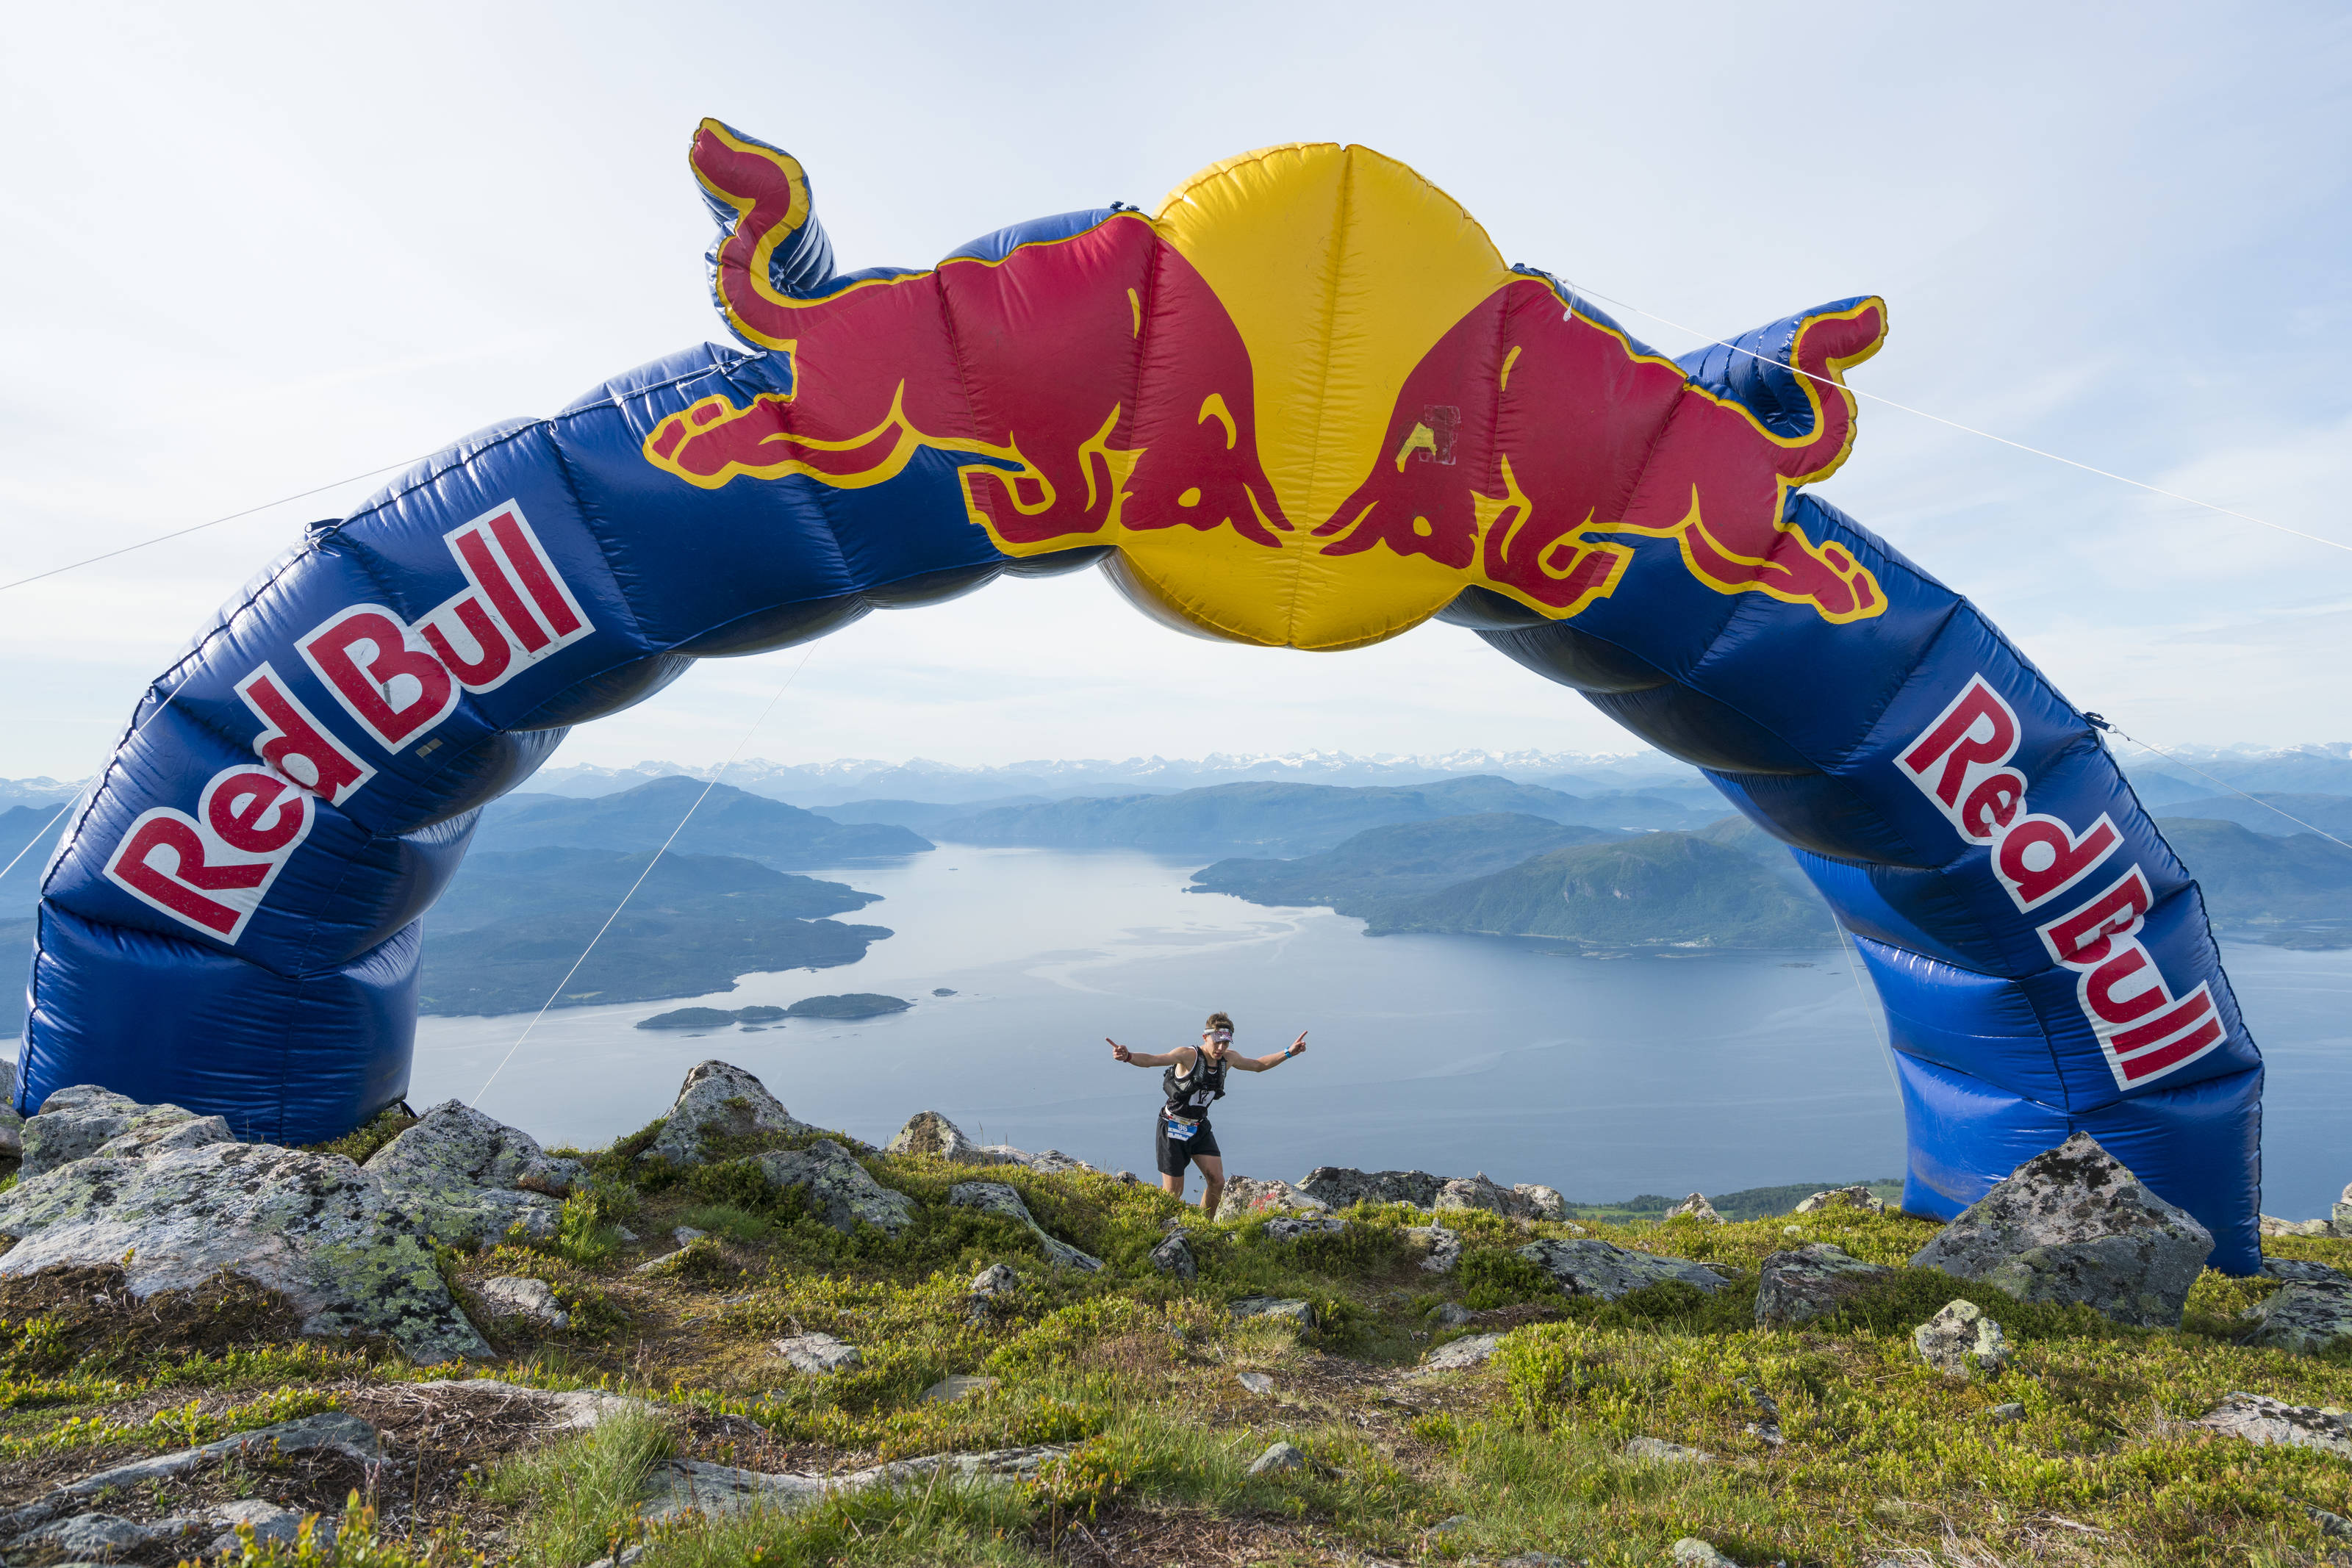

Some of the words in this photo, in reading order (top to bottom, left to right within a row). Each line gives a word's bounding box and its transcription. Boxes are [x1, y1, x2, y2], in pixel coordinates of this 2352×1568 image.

[110, 670, 368, 938] Red
[301, 506, 588, 748] Bull
[1899, 678, 2120, 908] Red
[2042, 868, 2224, 1085] Bull
